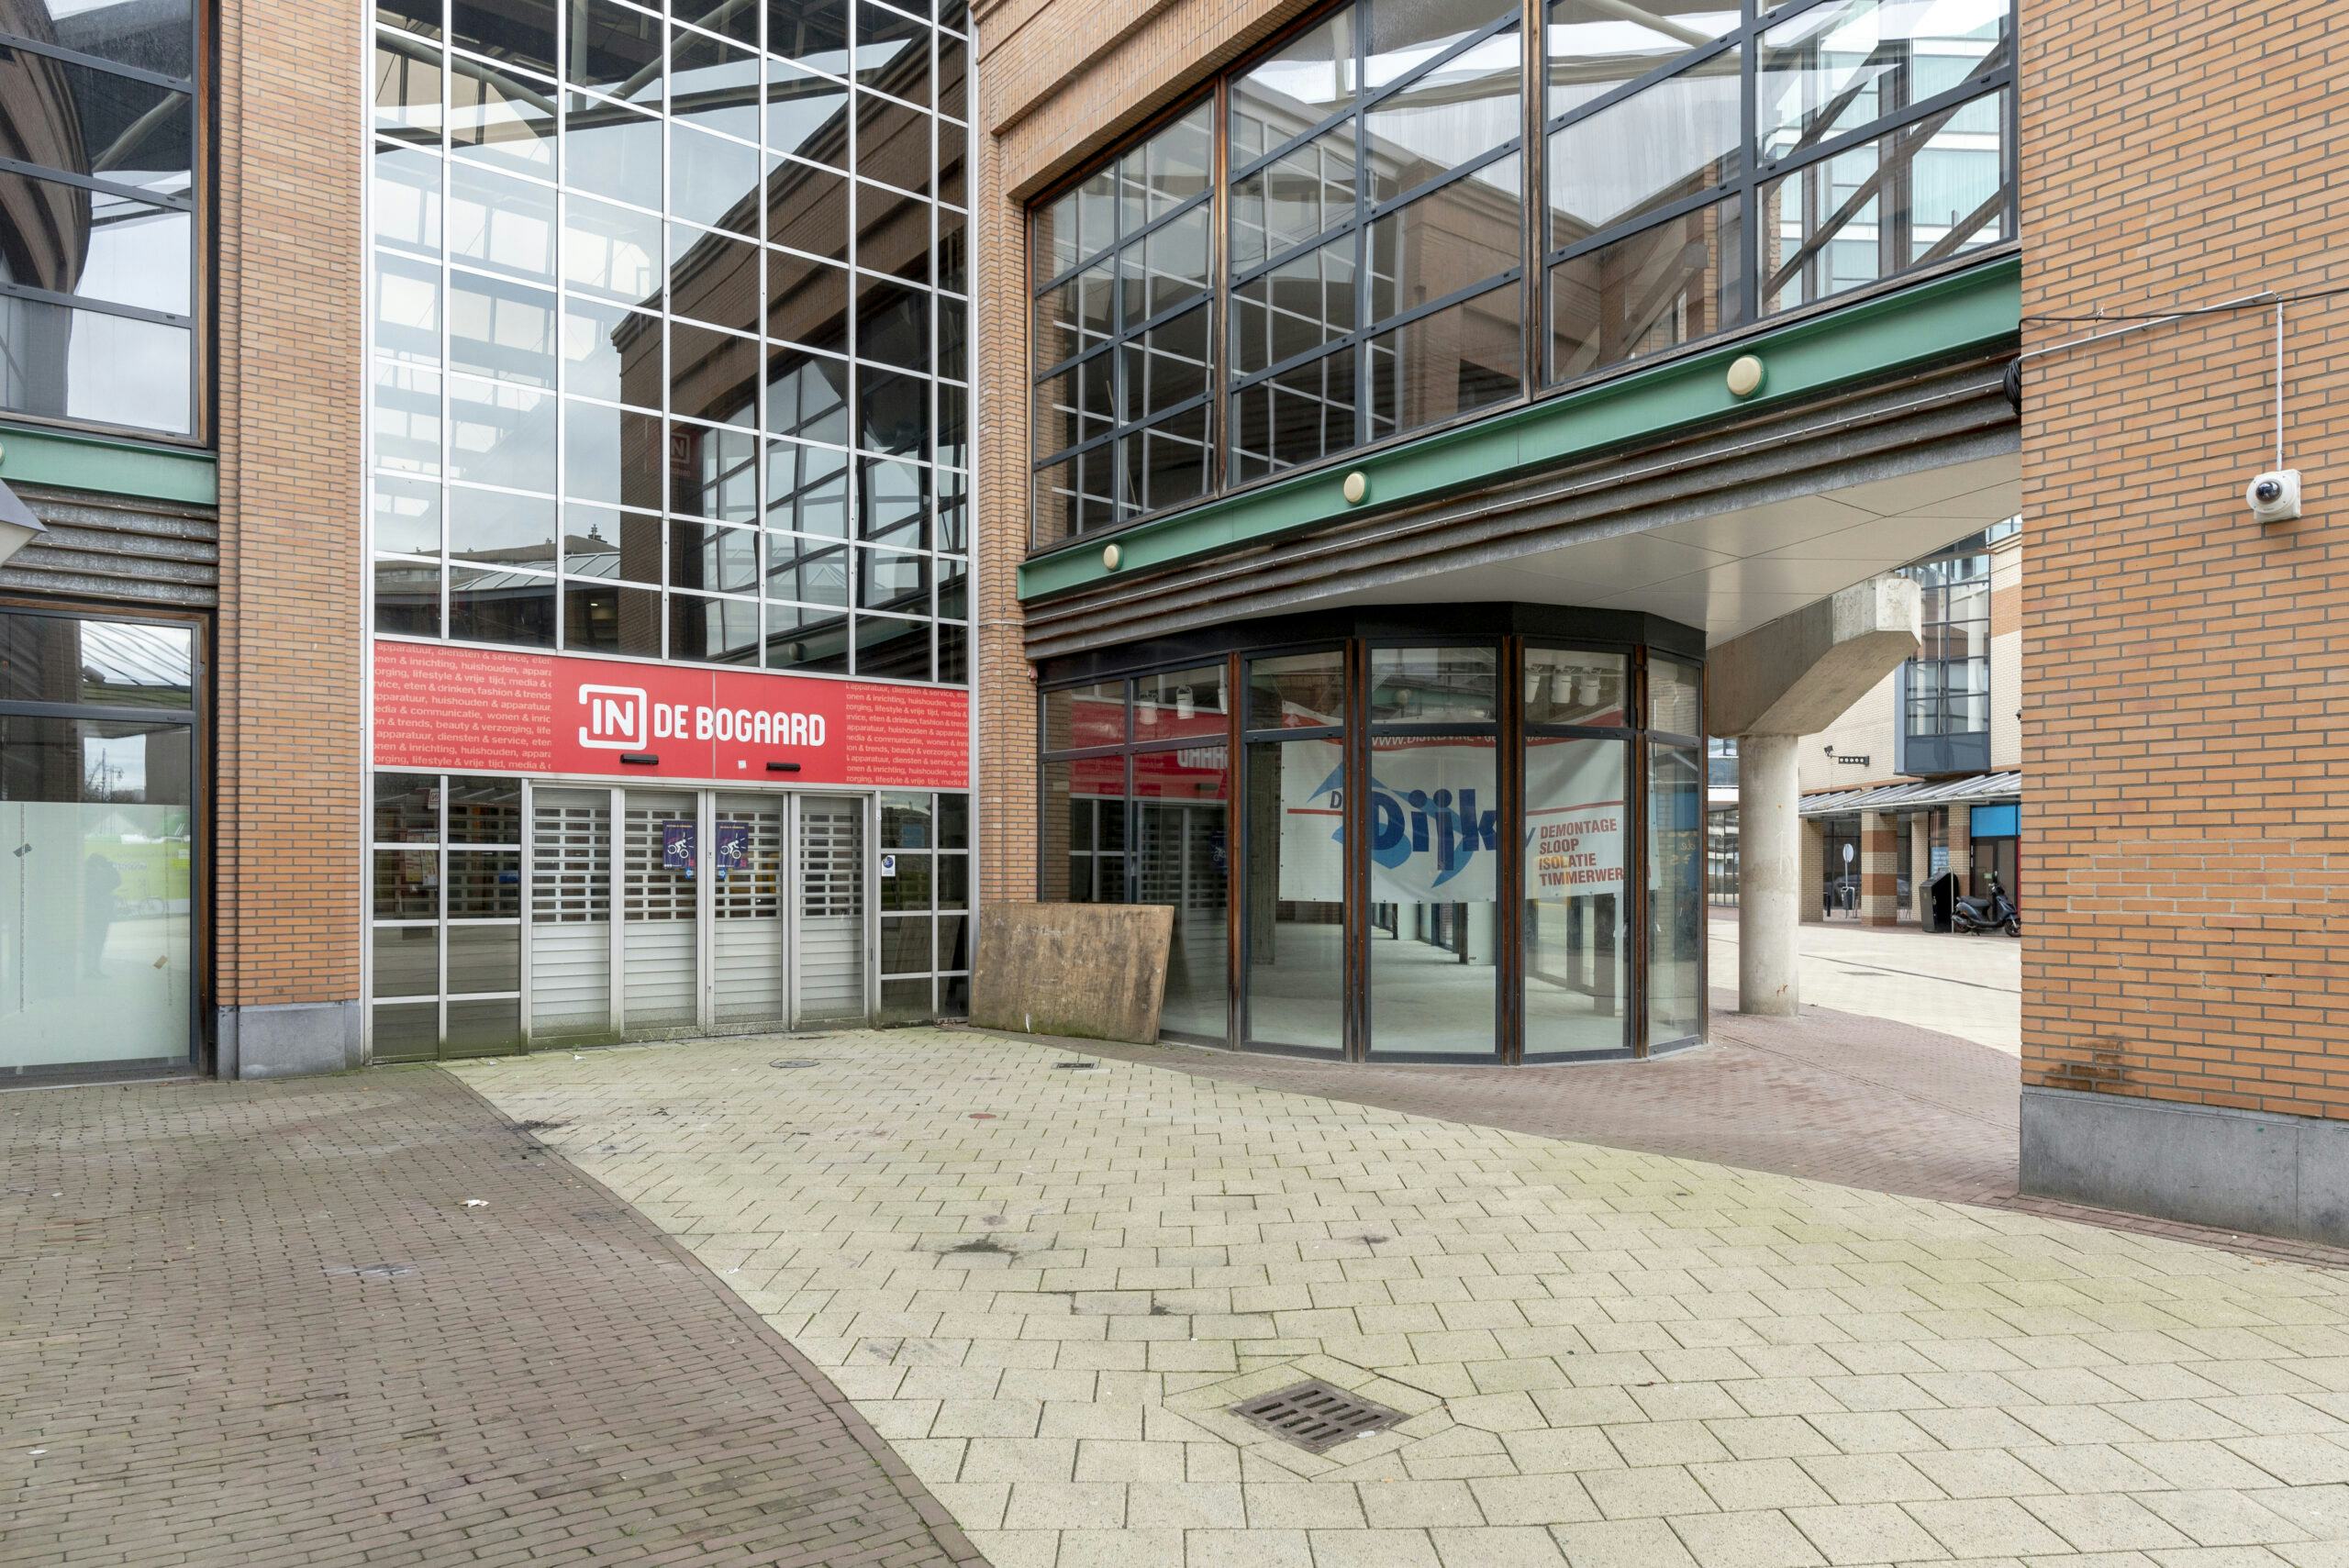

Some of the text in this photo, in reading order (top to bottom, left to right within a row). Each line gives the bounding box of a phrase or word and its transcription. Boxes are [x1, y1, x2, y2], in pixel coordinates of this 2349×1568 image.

[377, 644, 435, 656] apparatuur,
[438, 648, 479, 659] diensten
[483, 652, 490, 661] &
[492, 653, 529, 664] service,
[399, 656, 407, 665] &
[409, 657, 458, 671] inrichting,
[462, 662, 519, 676] huishouden,
[412, 670, 453, 682] lifestyle
[454, 673, 462, 682] &
[464, 674, 485, 684] vrije
[489, 675, 507, 686] tijd,
[509, 678, 539, 687] media
[404, 682, 427, 691] eten
[429, 683, 436, 692] &
[438, 684, 476, 695] drinken,
[478, 686, 513, 697] fashion
[515, 689, 522, 698] &
[432, 695, 488, 708] huishouden
[491, 699, 499, 708] &
[374, 705, 396, 714] edia
[400, 706, 407, 715] &
[410, 706, 483, 720] communicatie,
[487, 712, 519, 721] wonen
[522, 714, 529, 722] &
[593, 698, 826, 747] IN DE BOGAARD
[387, 717, 395, 726] &
[397, 717, 433, 730] trends,
[436, 720, 470, 732] beauty
[473, 722, 480, 731] &
[482, 724, 534, 735] verzorging,
[376, 730, 434, 741] apparatuur,
[438, 732, 480, 744] diensten
[482, 734, 490, 744] &
[492, 736, 529, 748] service,
[399, 742, 406, 751] &
[409, 743, 458, 755] inrichting,
[461, 745, 519, 758] huishouden,
[412, 755, 452, 767] lifestyle
[454, 757, 462, 766] &
[463, 759, 484, 769] vrije
[488, 759, 506, 769] tijd,
[508, 762, 537, 770] media
[1372, 788, 1497, 871] Dijk
[1540, 818, 1617, 840] DEMONTAGE
[1539, 839, 1579, 855] SLOOP
[1539, 853, 1597, 871] ISOLATIE
[1539, 865, 1651, 886] TIMMERWER
